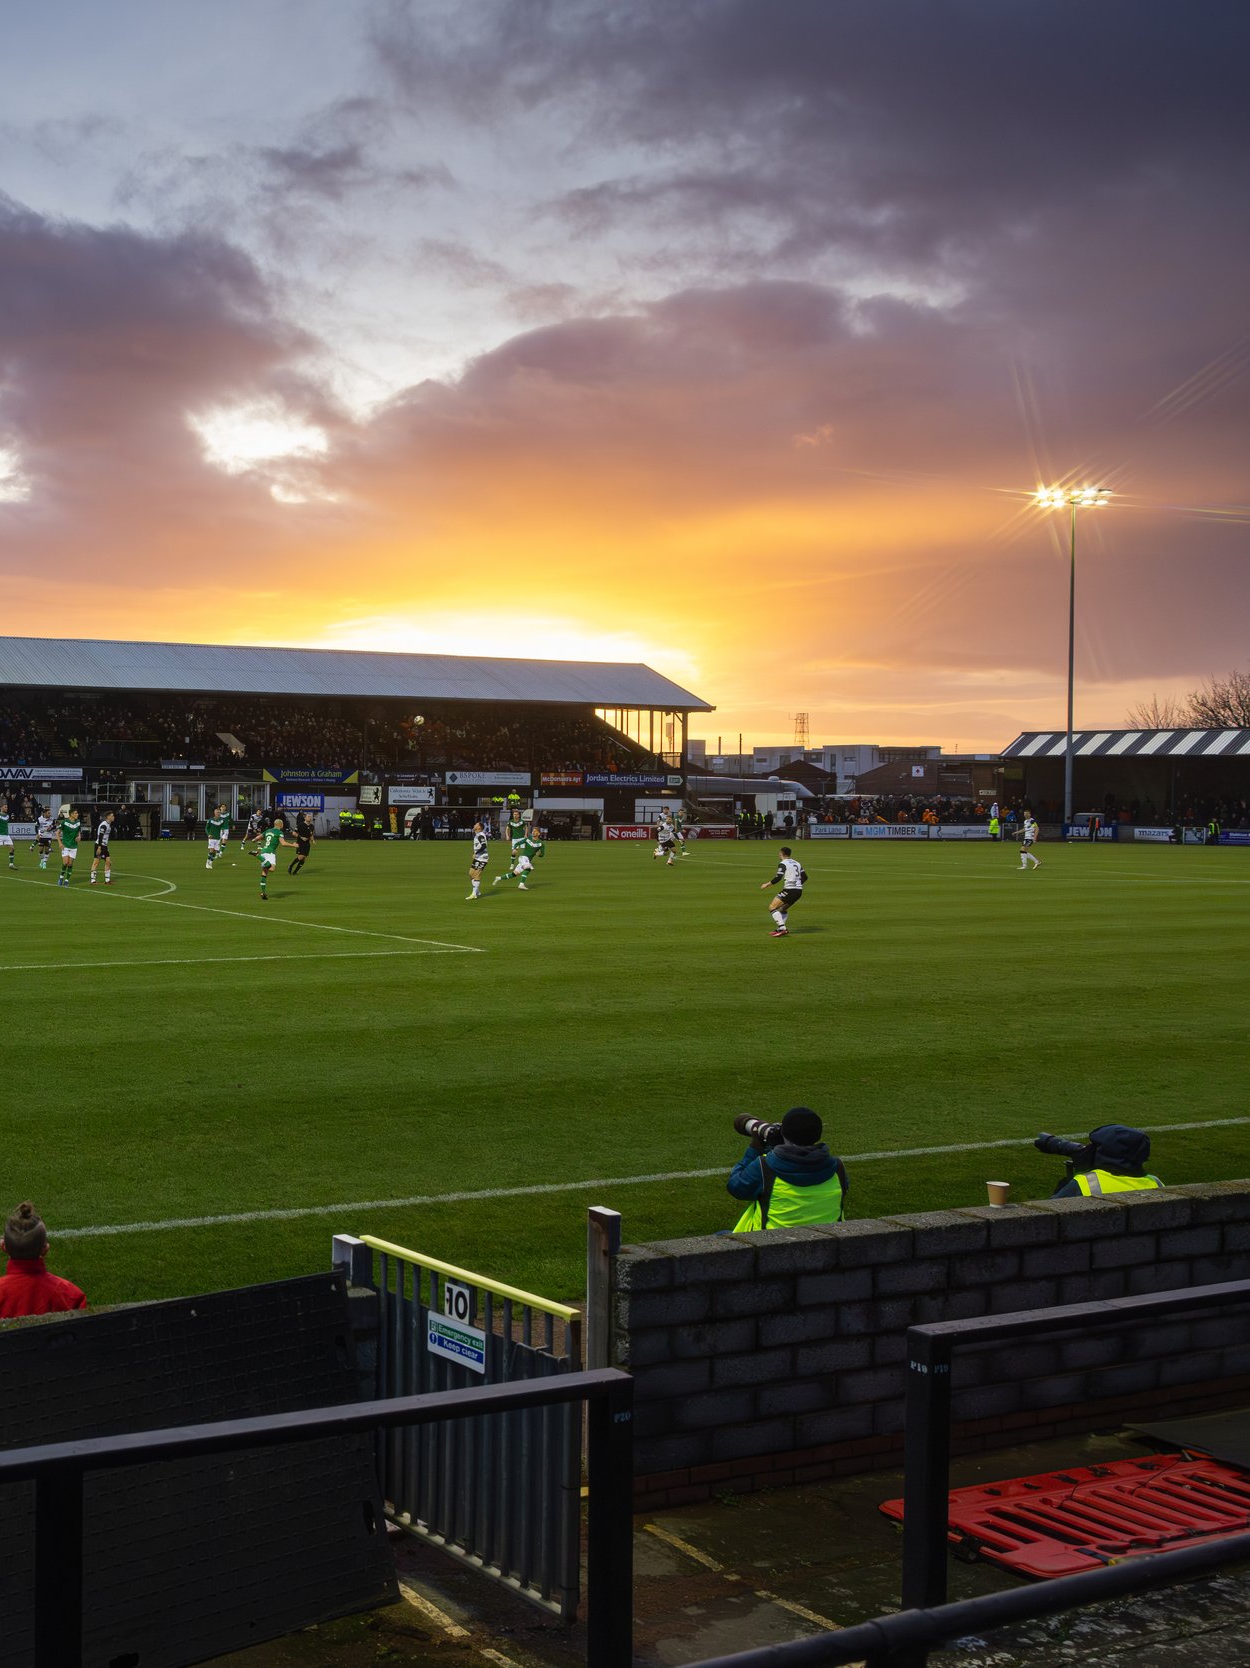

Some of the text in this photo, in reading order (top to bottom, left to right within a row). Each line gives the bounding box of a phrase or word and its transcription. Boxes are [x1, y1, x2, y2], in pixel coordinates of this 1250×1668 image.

[280, 770, 310, 778] Johnston
[317, 770, 342, 778] Graham
[586, 773, 609, 782] Jordan
[610, 774, 638, 782] Electrics
[639, 775, 665, 783] Limited
[280, 794, 321, 807] JEWSON
[11, 826, 31, 834] Lane
[621, 828, 648, 839] oneills
[865, 826, 916, 836] MGM TIMBER
[1066, 827, 1113, 837] JEWON
[265, 835, 272, 847] 8
[793, 864, 800, 877] 3
[446, 1286, 468, 1320] 10
[438, 1324, 484, 1350] Emergency exit
[443, 1338, 479, 1360] Keep clear
